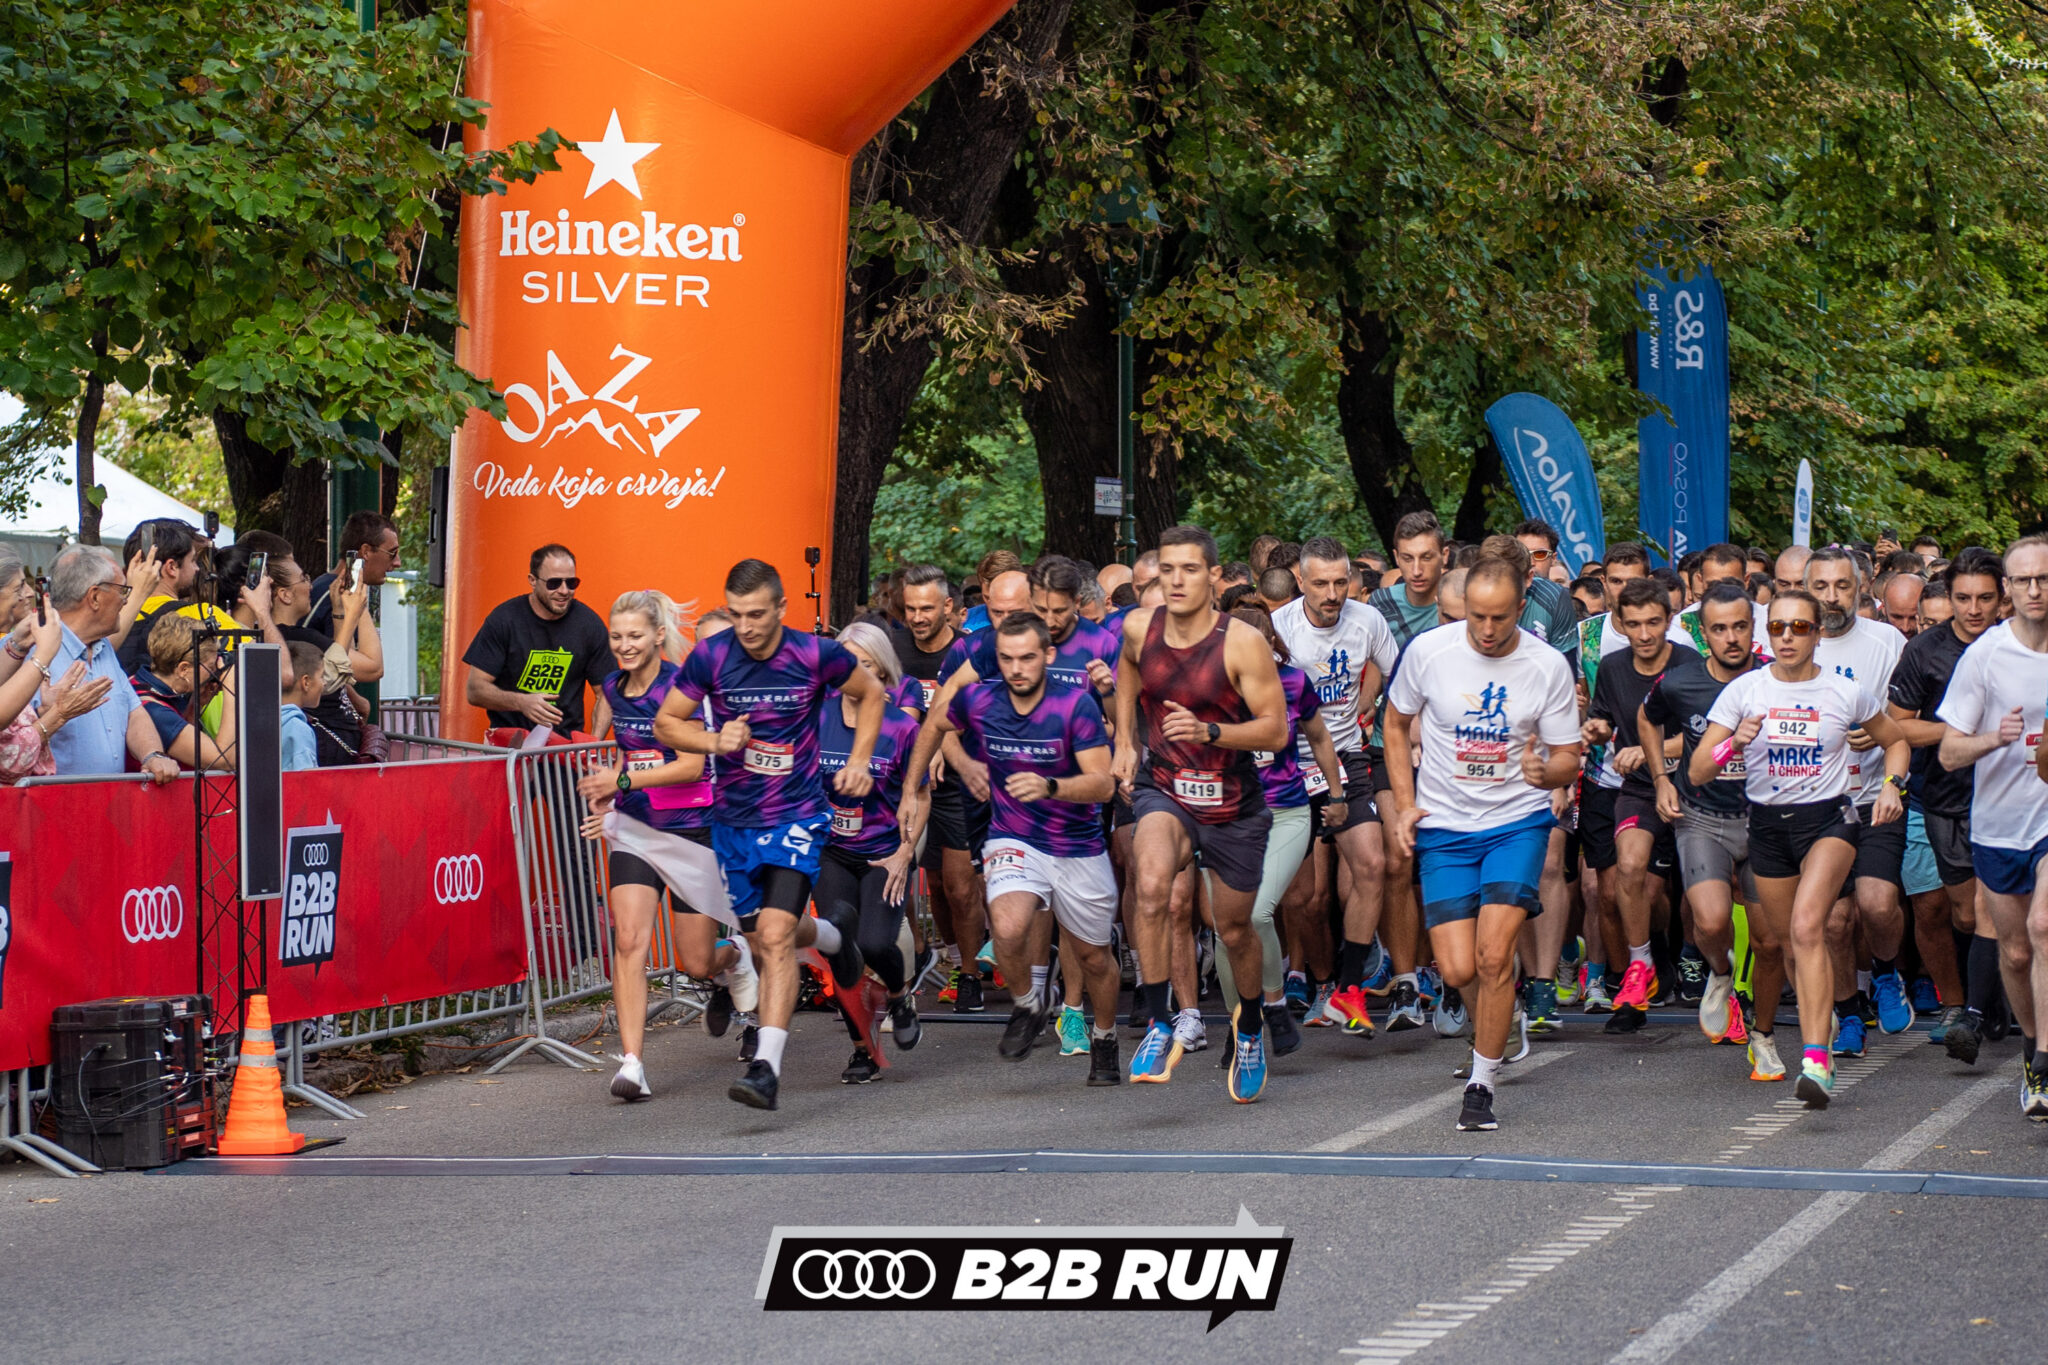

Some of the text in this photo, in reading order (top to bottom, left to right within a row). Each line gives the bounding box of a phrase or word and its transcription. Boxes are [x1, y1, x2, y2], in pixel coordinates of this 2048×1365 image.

[521, 270, 710, 308] SILVER
[500, 343, 701, 458] OAZA
[473, 461, 726, 509] Voda koja osvaja!
[528, 664, 565, 678] B2B
[523, 677, 560, 691] RUN
[727, 694, 799, 703] ALMA RAS
[1456, 725, 1510, 742] MAKE
[1779, 721, 1807, 735] 942
[754, 753, 782, 767] 975
[1768, 747, 1823, 766] MAKE
[1467, 763, 1495, 777] 954
[1769, 765, 1822, 777] A CHANGE
[1181, 782, 1215, 797] 1419
[288, 871, 336, 917] B2B
[286, 915, 333, 958] RUN
